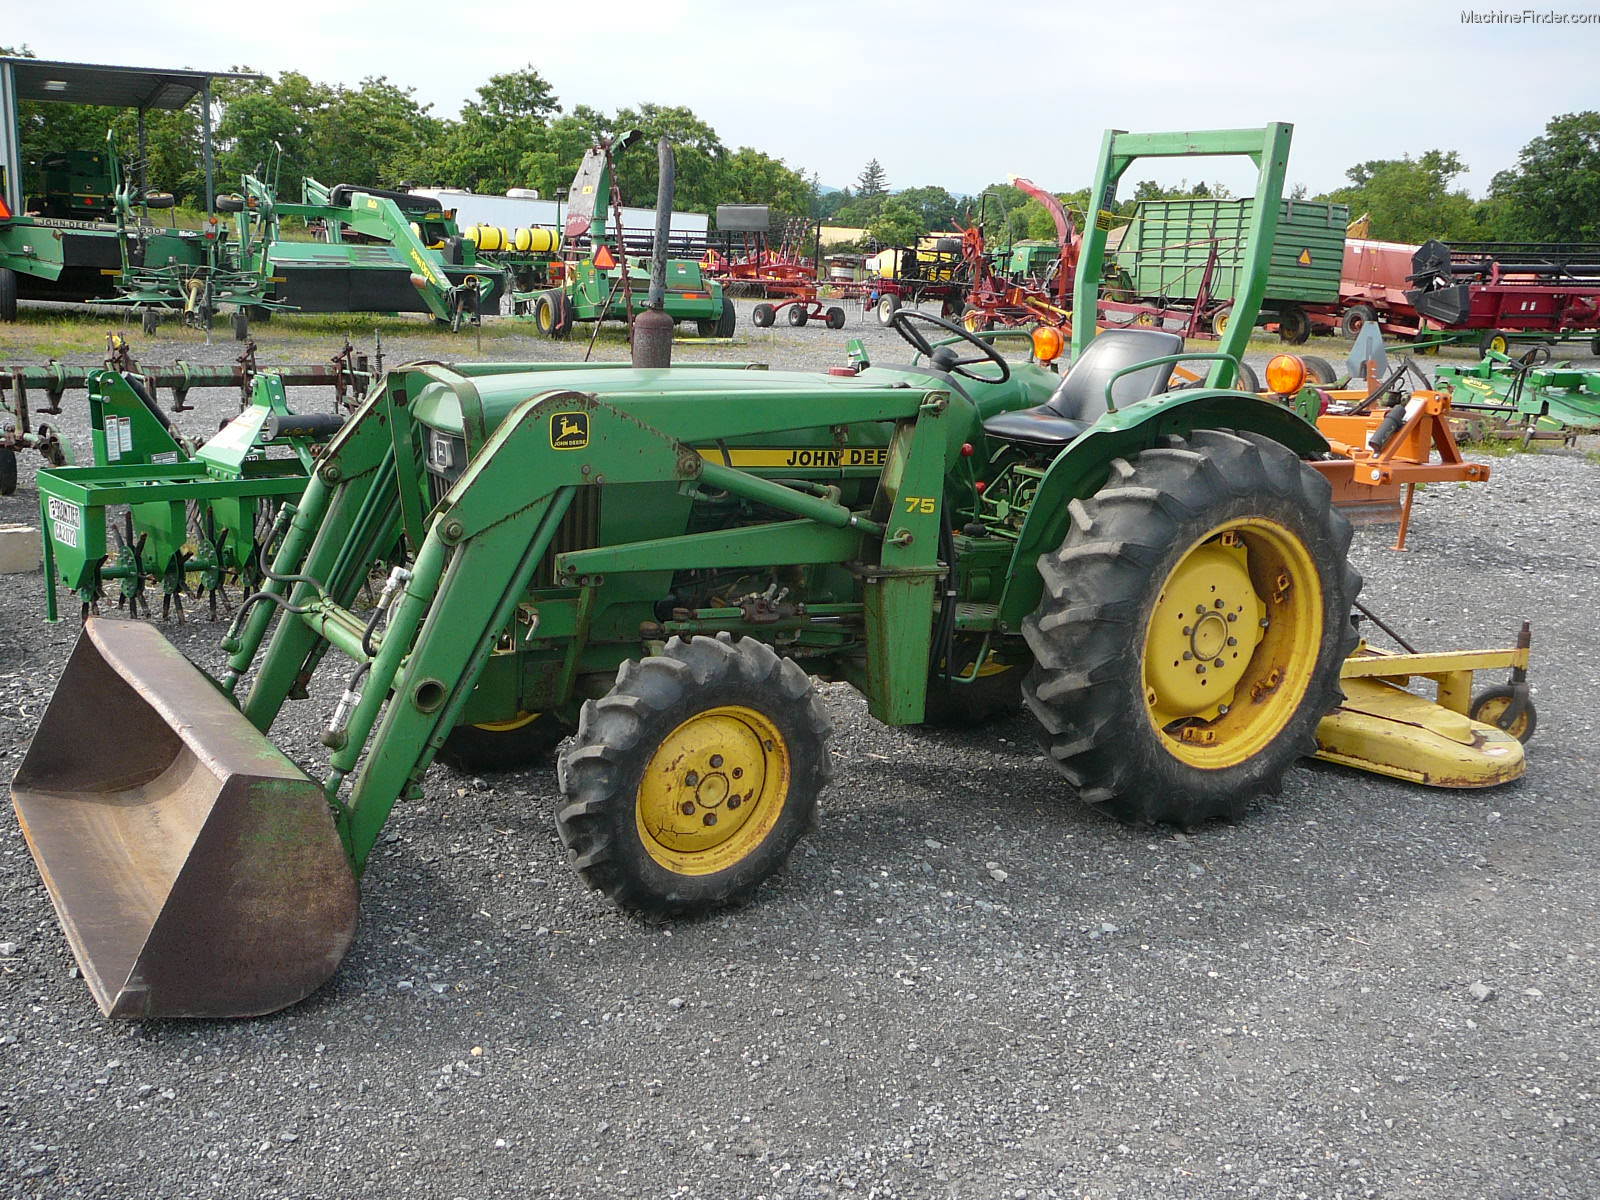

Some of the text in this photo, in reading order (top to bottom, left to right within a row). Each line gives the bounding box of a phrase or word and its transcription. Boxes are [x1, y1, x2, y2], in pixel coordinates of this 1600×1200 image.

[39, 220, 99, 230] JOHN DEERE
[786, 449, 888, 466] JOHN DEE
[904, 497, 935, 514] 75
